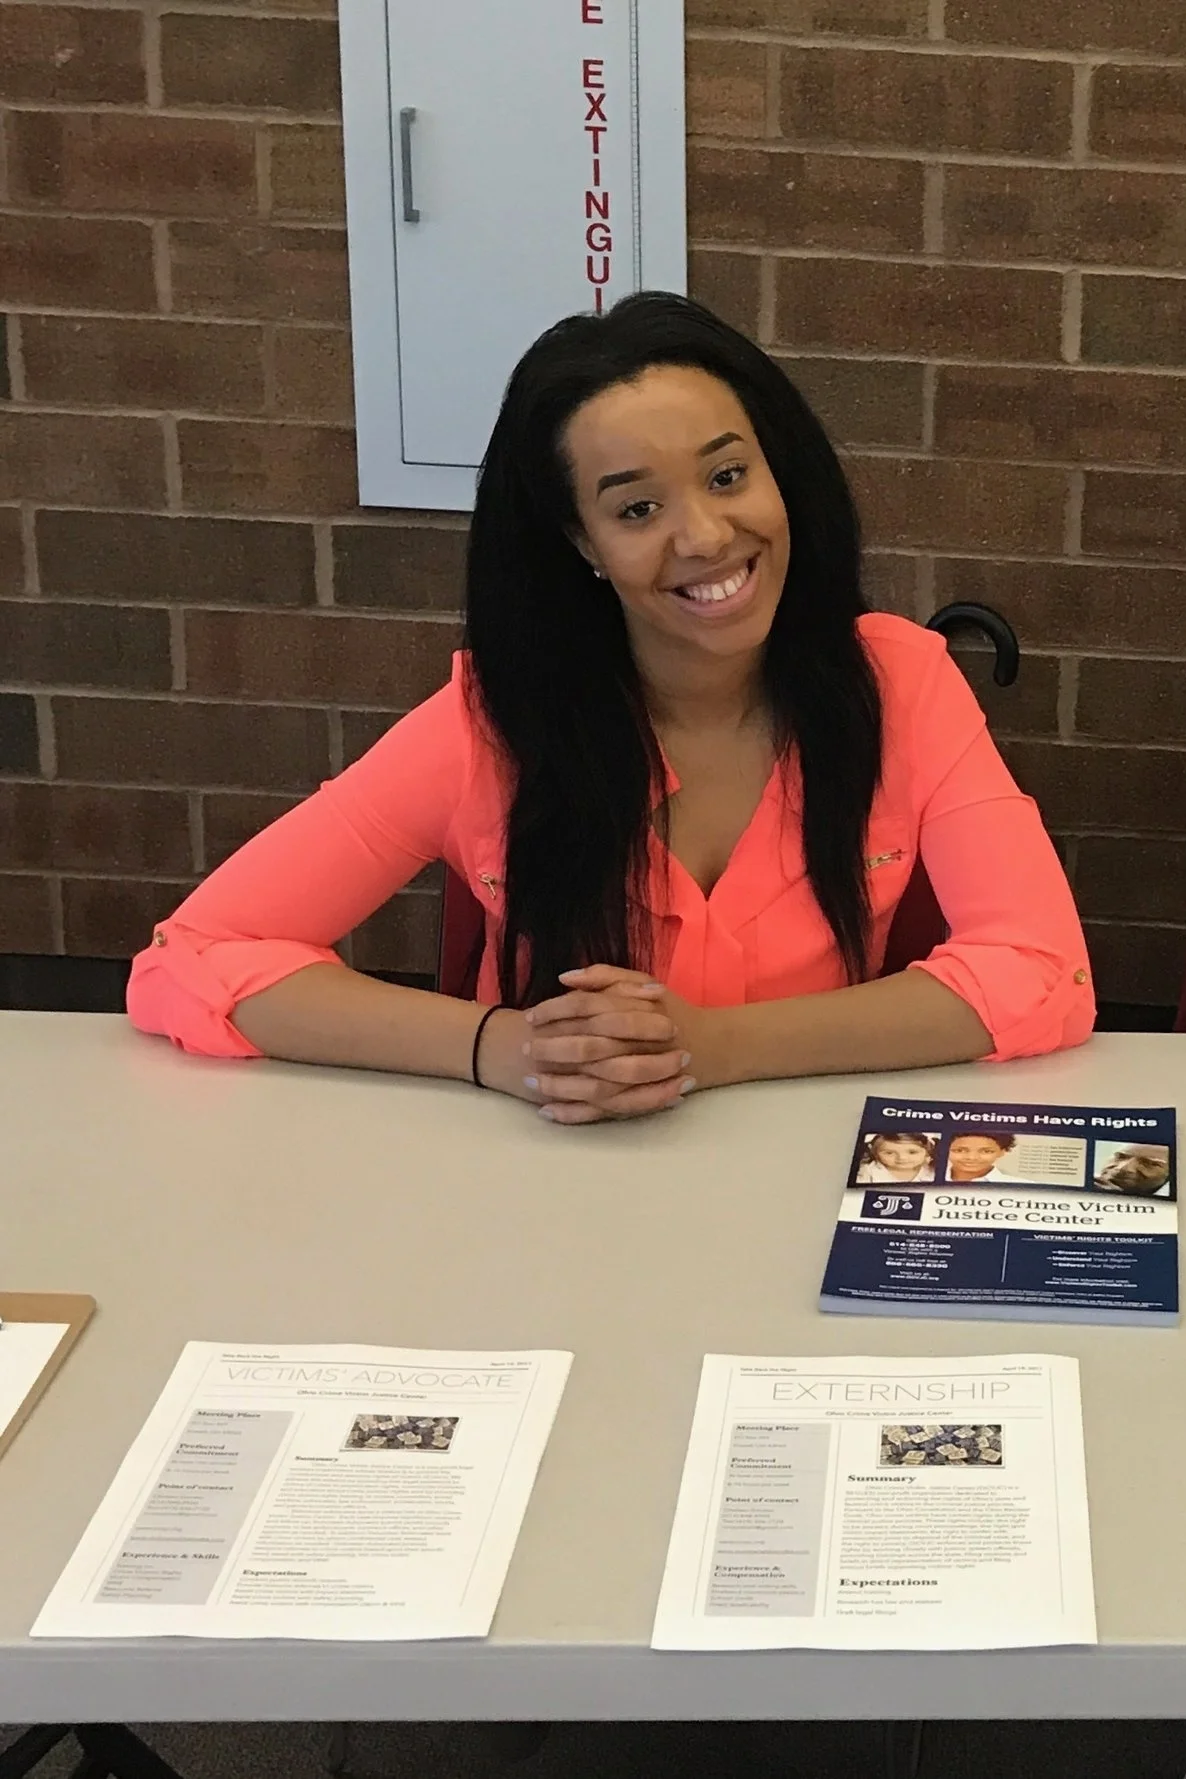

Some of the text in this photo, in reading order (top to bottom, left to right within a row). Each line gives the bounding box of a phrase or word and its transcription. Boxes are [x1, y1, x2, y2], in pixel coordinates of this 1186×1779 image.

[882, 1107, 1158, 1129] Crime Victims Have Rights
[935, 1195, 1156, 1214] Ohio Crime Victim
[932, 1208, 1105, 1225] Justice Center
[226, 1366, 513, 1388] VICTIMS' ADVOCATE
[772, 1382, 1011, 1401] EXTERNSHIP
[242, 1569, 308, 1578] Expectations
[839, 1578, 939, 1588] Expectations
